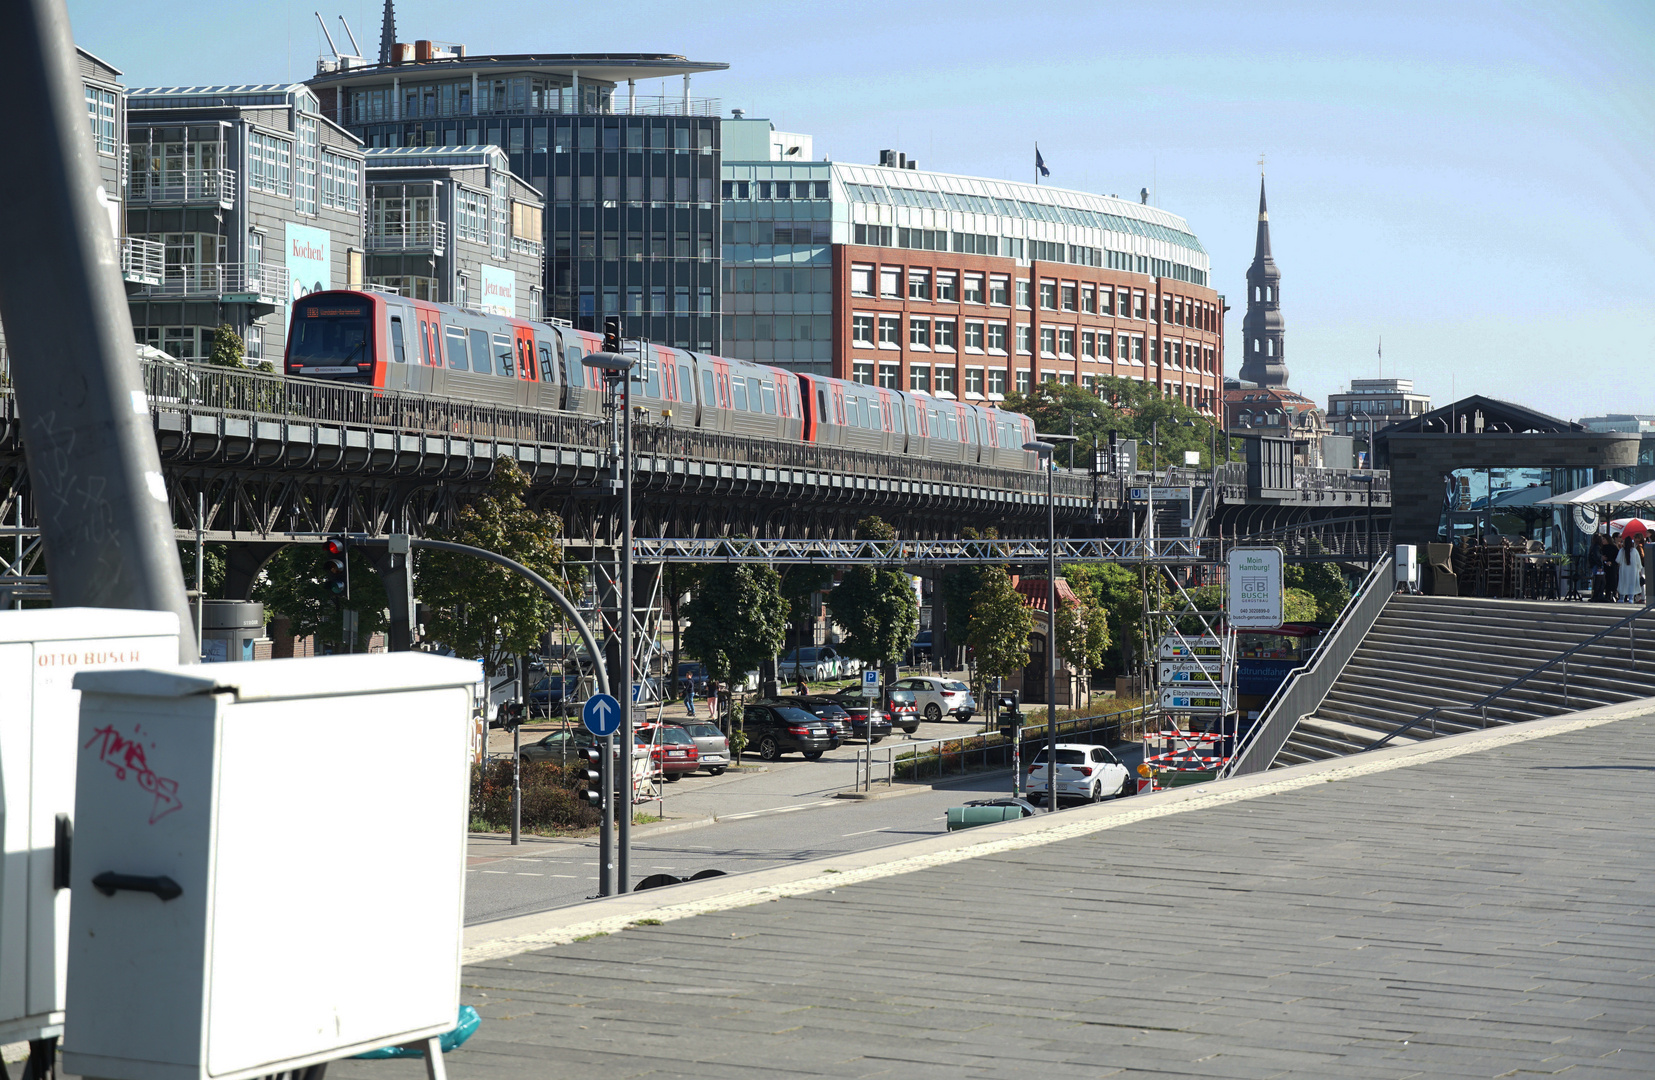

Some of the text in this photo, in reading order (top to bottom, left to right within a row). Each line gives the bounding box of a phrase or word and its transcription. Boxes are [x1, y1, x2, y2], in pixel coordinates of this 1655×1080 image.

[292, 238, 324, 262] Kochen!
[484, 277, 512, 298] Jetzt neu!
[1239, 564, 1270, 572] Hamburg!
[38, 650, 140, 667] OTTO BUSCH
